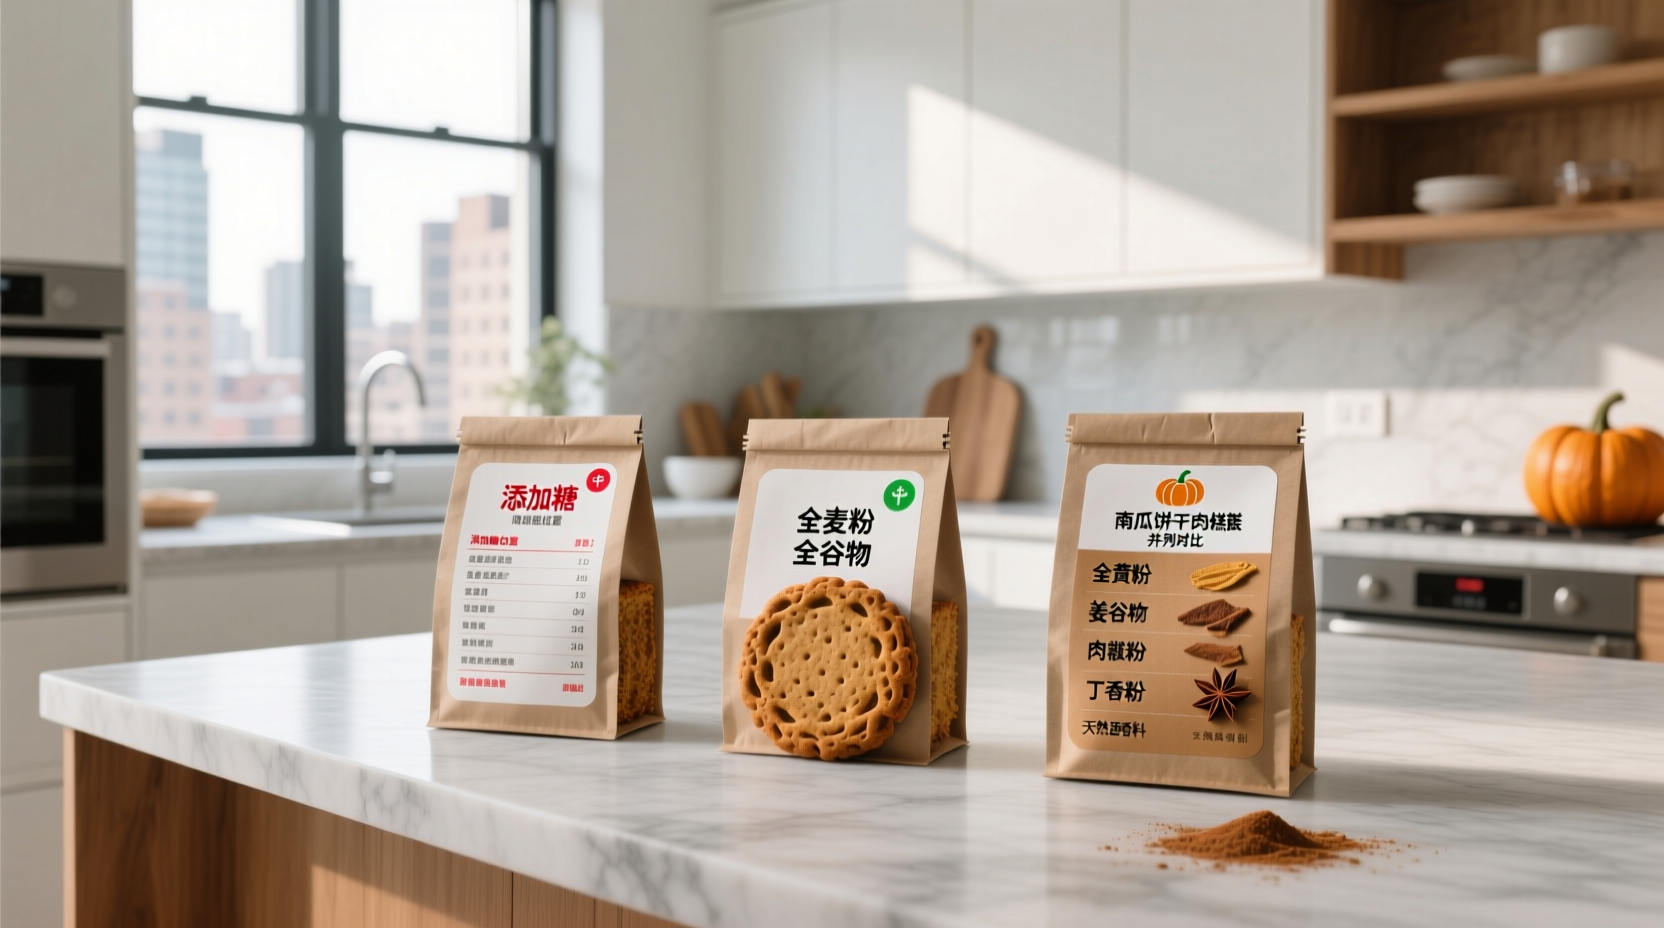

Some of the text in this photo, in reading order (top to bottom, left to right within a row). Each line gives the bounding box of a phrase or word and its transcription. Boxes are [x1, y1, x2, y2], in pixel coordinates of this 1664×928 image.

[500, 484, 579, 512] 添加糖
[797, 506, 875, 535] 全麦粉
[792, 539, 872, 567] 全谷物
[1086, 680, 1146, 703] 丁香粉
